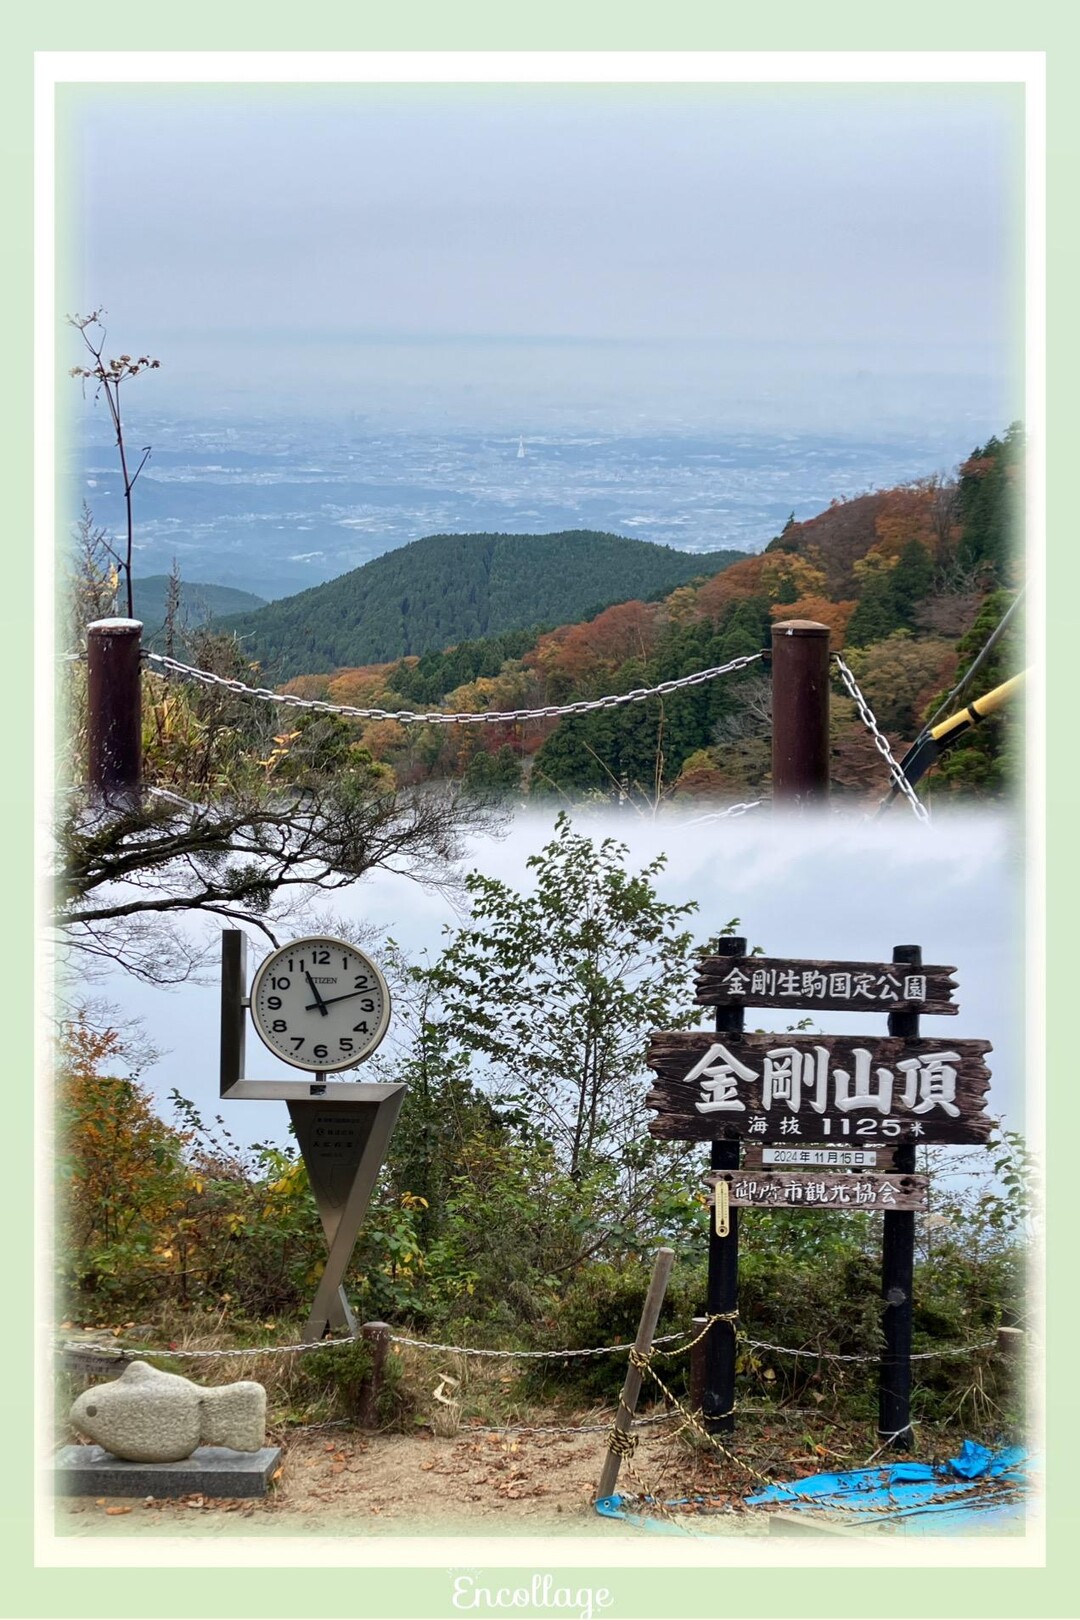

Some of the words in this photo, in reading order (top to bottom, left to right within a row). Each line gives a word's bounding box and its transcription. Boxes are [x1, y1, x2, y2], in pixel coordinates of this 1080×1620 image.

[312, 951, 330, 965] 12
[342, 957, 348, 970] 1
[288, 959, 305, 972] 11
[271, 977, 290, 990] 10
[305, 976, 338, 984] CTIZEN
[354, 975, 368, 989] 2
[722, 967, 927, 1003] 金剛生駒国定公園
[267, 996, 282, 1010] 9
[360, 998, 374, 1012] 3
[272, 1019, 287, 1033] 8
[353, 1021, 368, 1034] 4
[290, 1037, 305, 1050] 7
[339, 1038, 353, 1051] 5
[314, 1044, 328, 1058] 6
[683, 1042, 962, 1118] 金剛山頂
